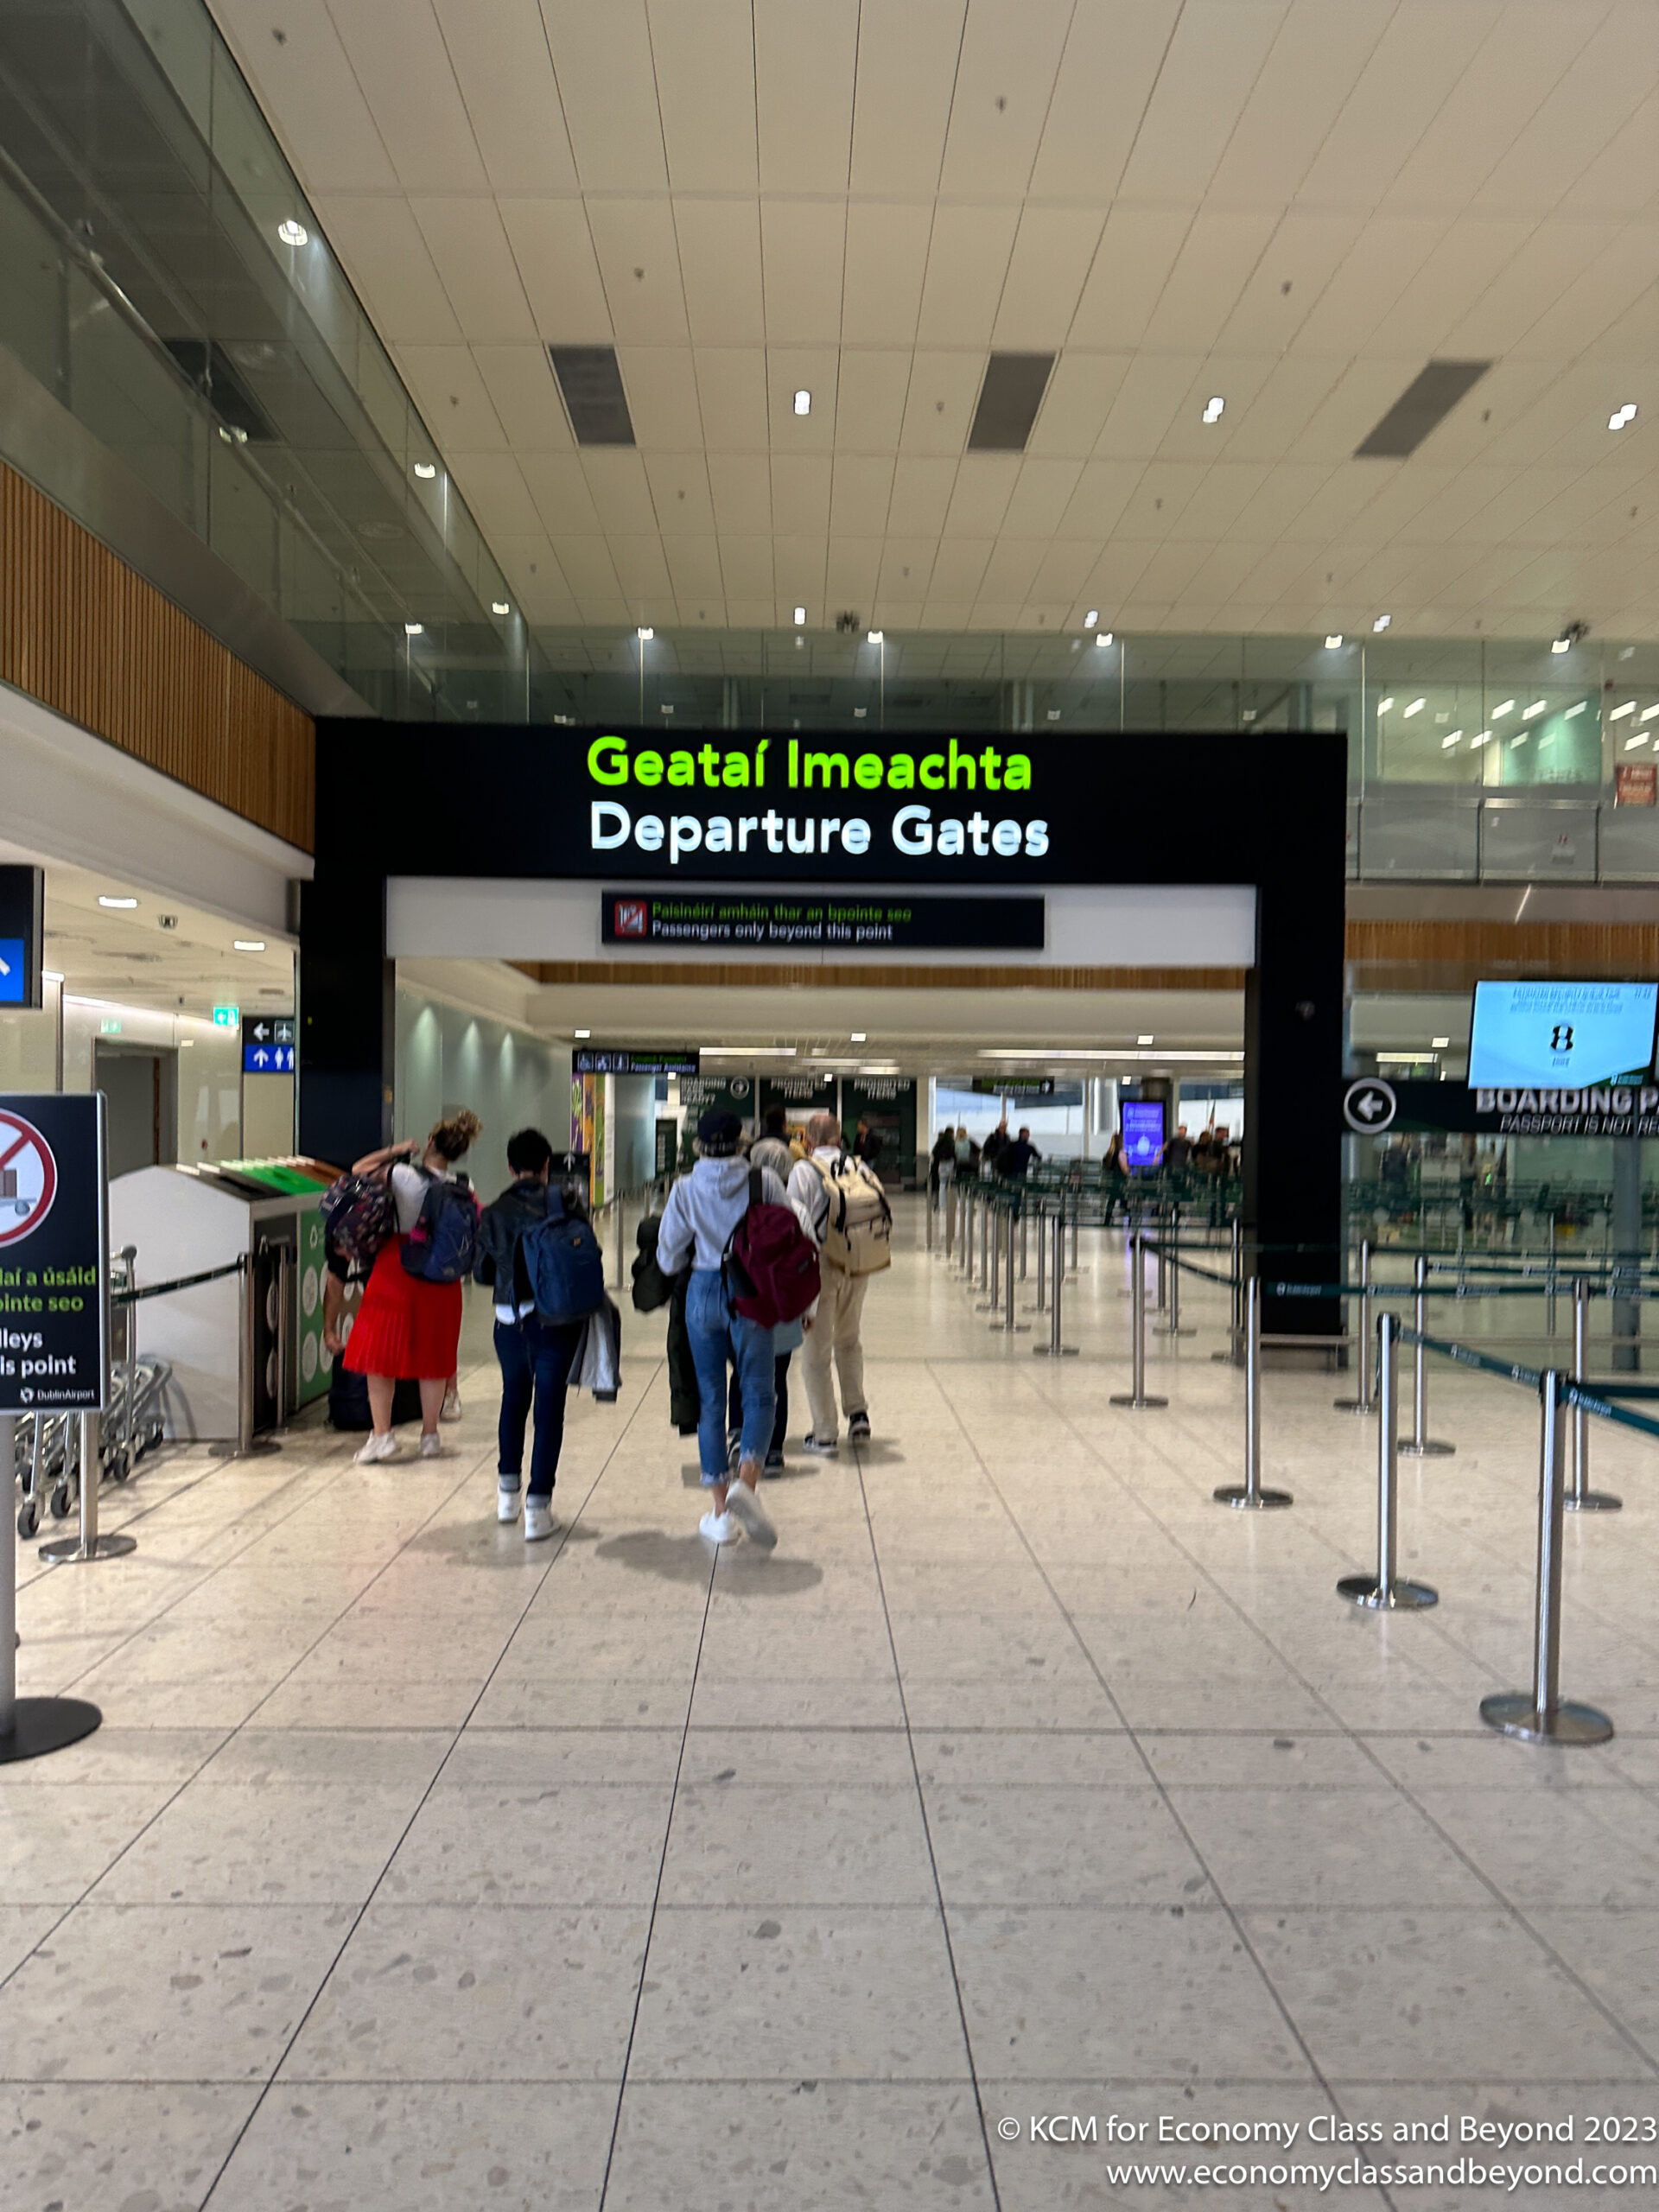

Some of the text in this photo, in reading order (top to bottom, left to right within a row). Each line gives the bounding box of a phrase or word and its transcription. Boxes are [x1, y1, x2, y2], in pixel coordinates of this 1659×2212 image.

[588, 735, 1032, 791] Geataí Imeachta
[590, 801, 1050, 864] Departure Gates
[807, 906, 823, 921] an
[652, 919, 893, 943] Passengers only beyond this point
[1550, 1023, 1574, 1052] 8
[1476, 1087, 1633, 1116] BOARDING
[1500, 1114, 1580, 1135] PASSPORT
[1584, 1115, 1599, 1135] IS
[1602, 1115, 1633, 1135] NOT
[26, 1271, 37, 1287] a
[44, 1265, 97, 1287] úsáid
[48, 1296, 84, 1313] seo
[22, 1354, 77, 1379] point
